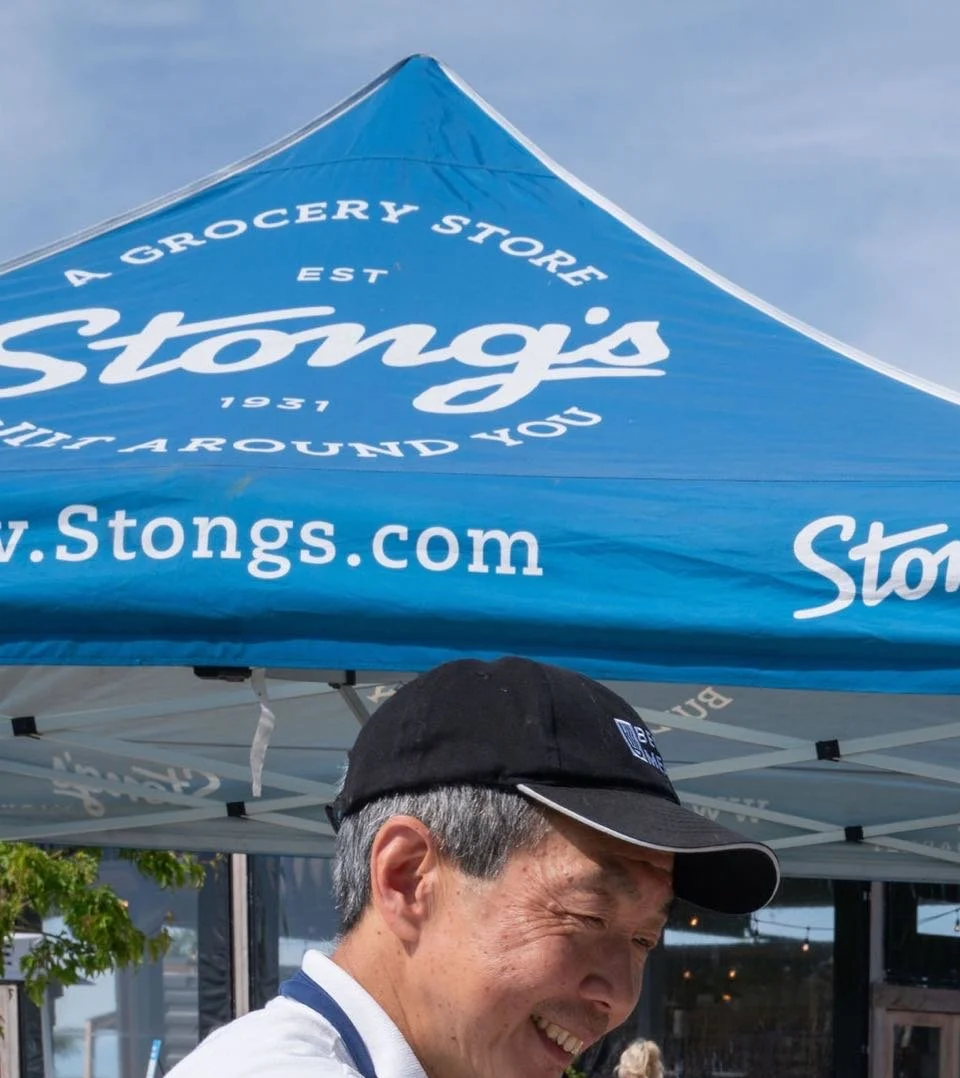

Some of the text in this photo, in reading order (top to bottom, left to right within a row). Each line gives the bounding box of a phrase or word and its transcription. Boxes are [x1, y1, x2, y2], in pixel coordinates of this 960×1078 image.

[63, 200, 608, 287] A GROCERY STORE
[297, 267, 388, 284] EST
[0, 306, 671, 414] Stong's
[220, 396, 330, 413] 1931
[117, 437, 459, 458] AROUND
[470, 406, 602, 447] YOU
